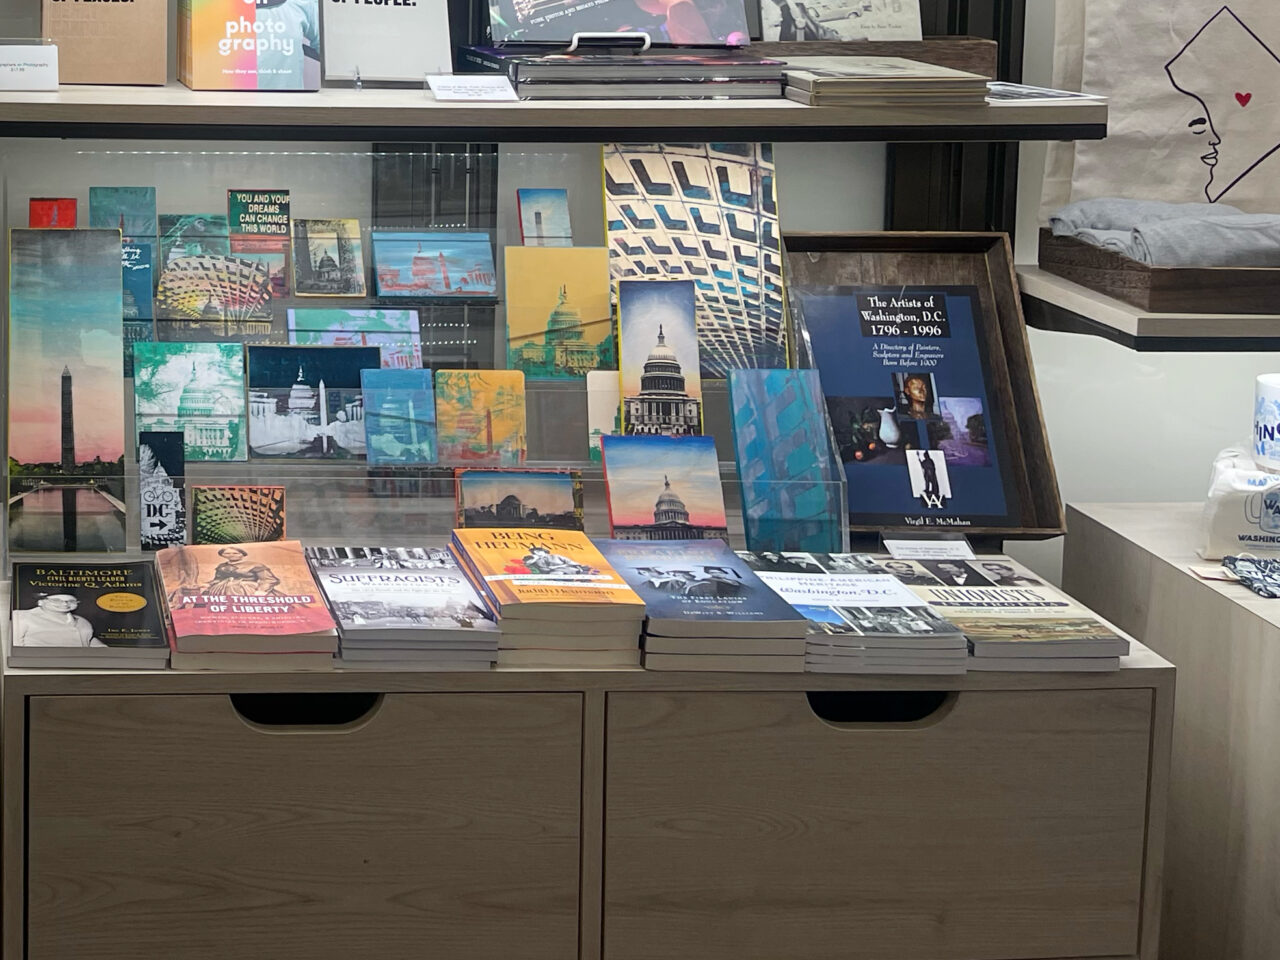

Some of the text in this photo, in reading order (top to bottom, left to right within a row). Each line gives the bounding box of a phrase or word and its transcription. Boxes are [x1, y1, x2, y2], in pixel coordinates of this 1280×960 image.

[226, 16, 286, 37] photo
[218, 34, 294, 56] graphy
[237, 193, 252, 202] YOU
[254, 194, 269, 202] AND
[248, 205, 280, 213] DREAMS
[240, 214, 288, 224] CAN CHANGE
[241, 224, 287, 234] THIS WORLD
[867, 296, 935, 308] The Artists of
[861, 310, 946, 323] Washington, D.C.
[871, 325, 942, 336] 1796 1996
[880, 343, 907, 351] Directory
[146, 504, 171, 517] DC
[905, 516, 924, 526] Virgil
[936, 517, 971, 526] McMahan
[491, 532, 554, 540] BEING
[475, 541, 584, 551] HEUMANN
[329, 573, 461, 584] SUFFRAGISTS
[231, 596, 311, 604] THRESHOLD
[929, 589, 1046, 601] UNIONISTS
[232, 605, 289, 613] LIBERTY
